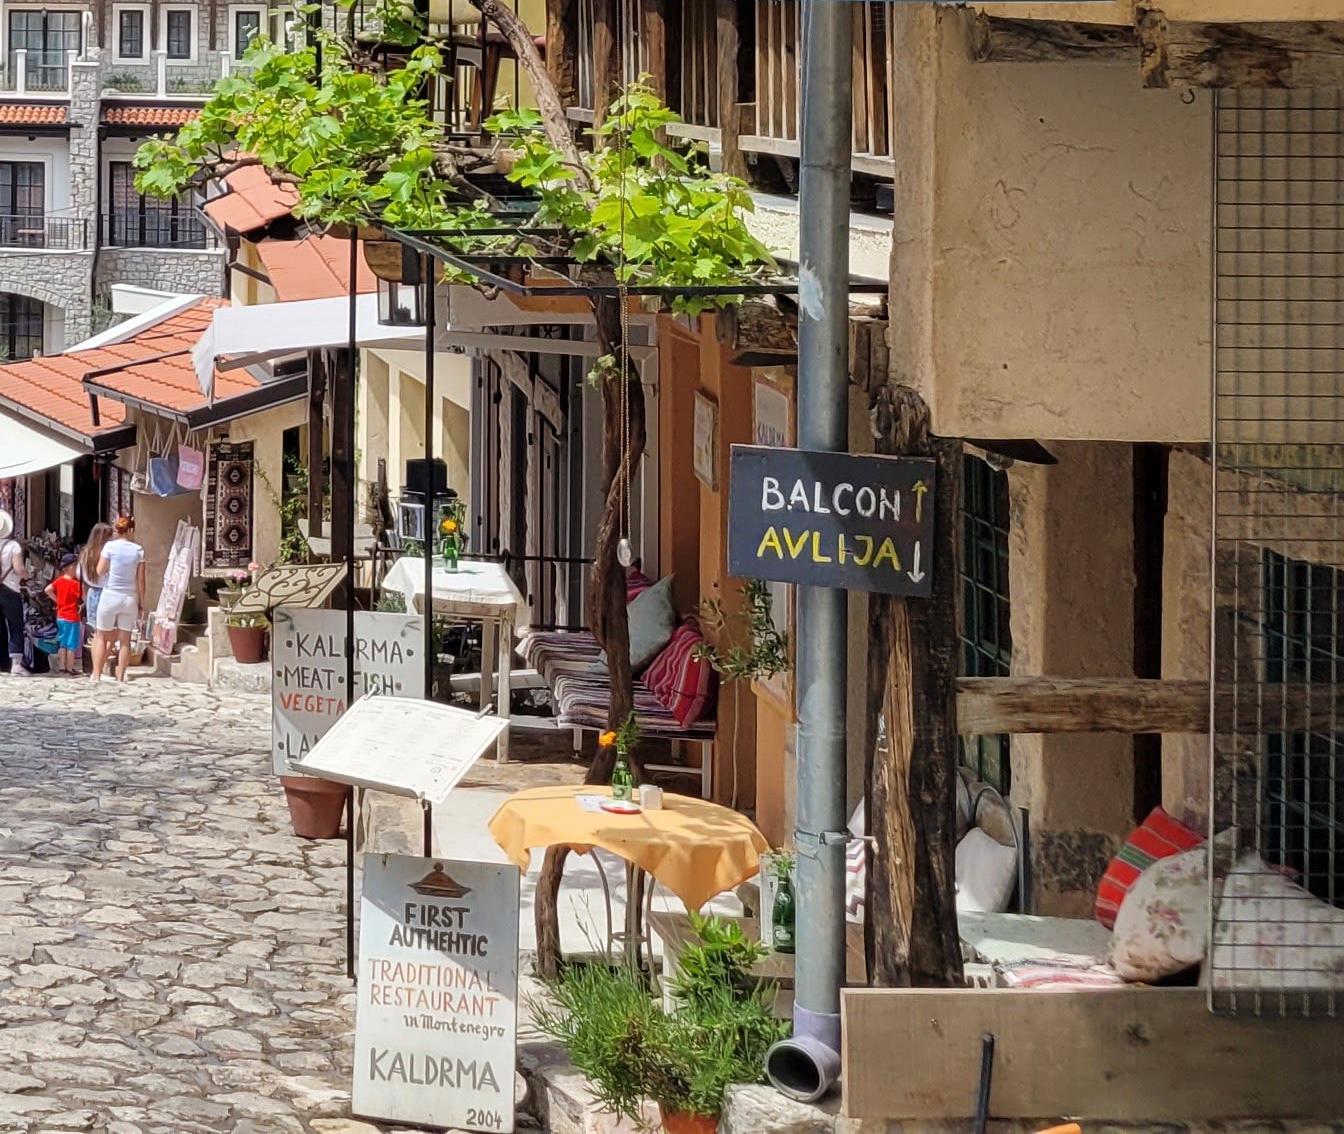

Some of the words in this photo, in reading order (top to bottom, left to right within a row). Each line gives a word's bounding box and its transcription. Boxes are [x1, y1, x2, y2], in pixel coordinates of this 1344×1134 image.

[761, 476, 901, 522] BALCON
[756, 526, 902, 572] AVLIJA
[284, 664, 336, 691] MEAT
[405, 902, 471, 929] FIRST
[367, 957, 500, 993] TRADITIONAL
[370, 983, 500, 1017] RESTAURANT
[420, 1013, 506, 1042] Montenegro
[369, 1046, 501, 1094] KALDRMA
[465, 1108, 503, 1130] 2004
